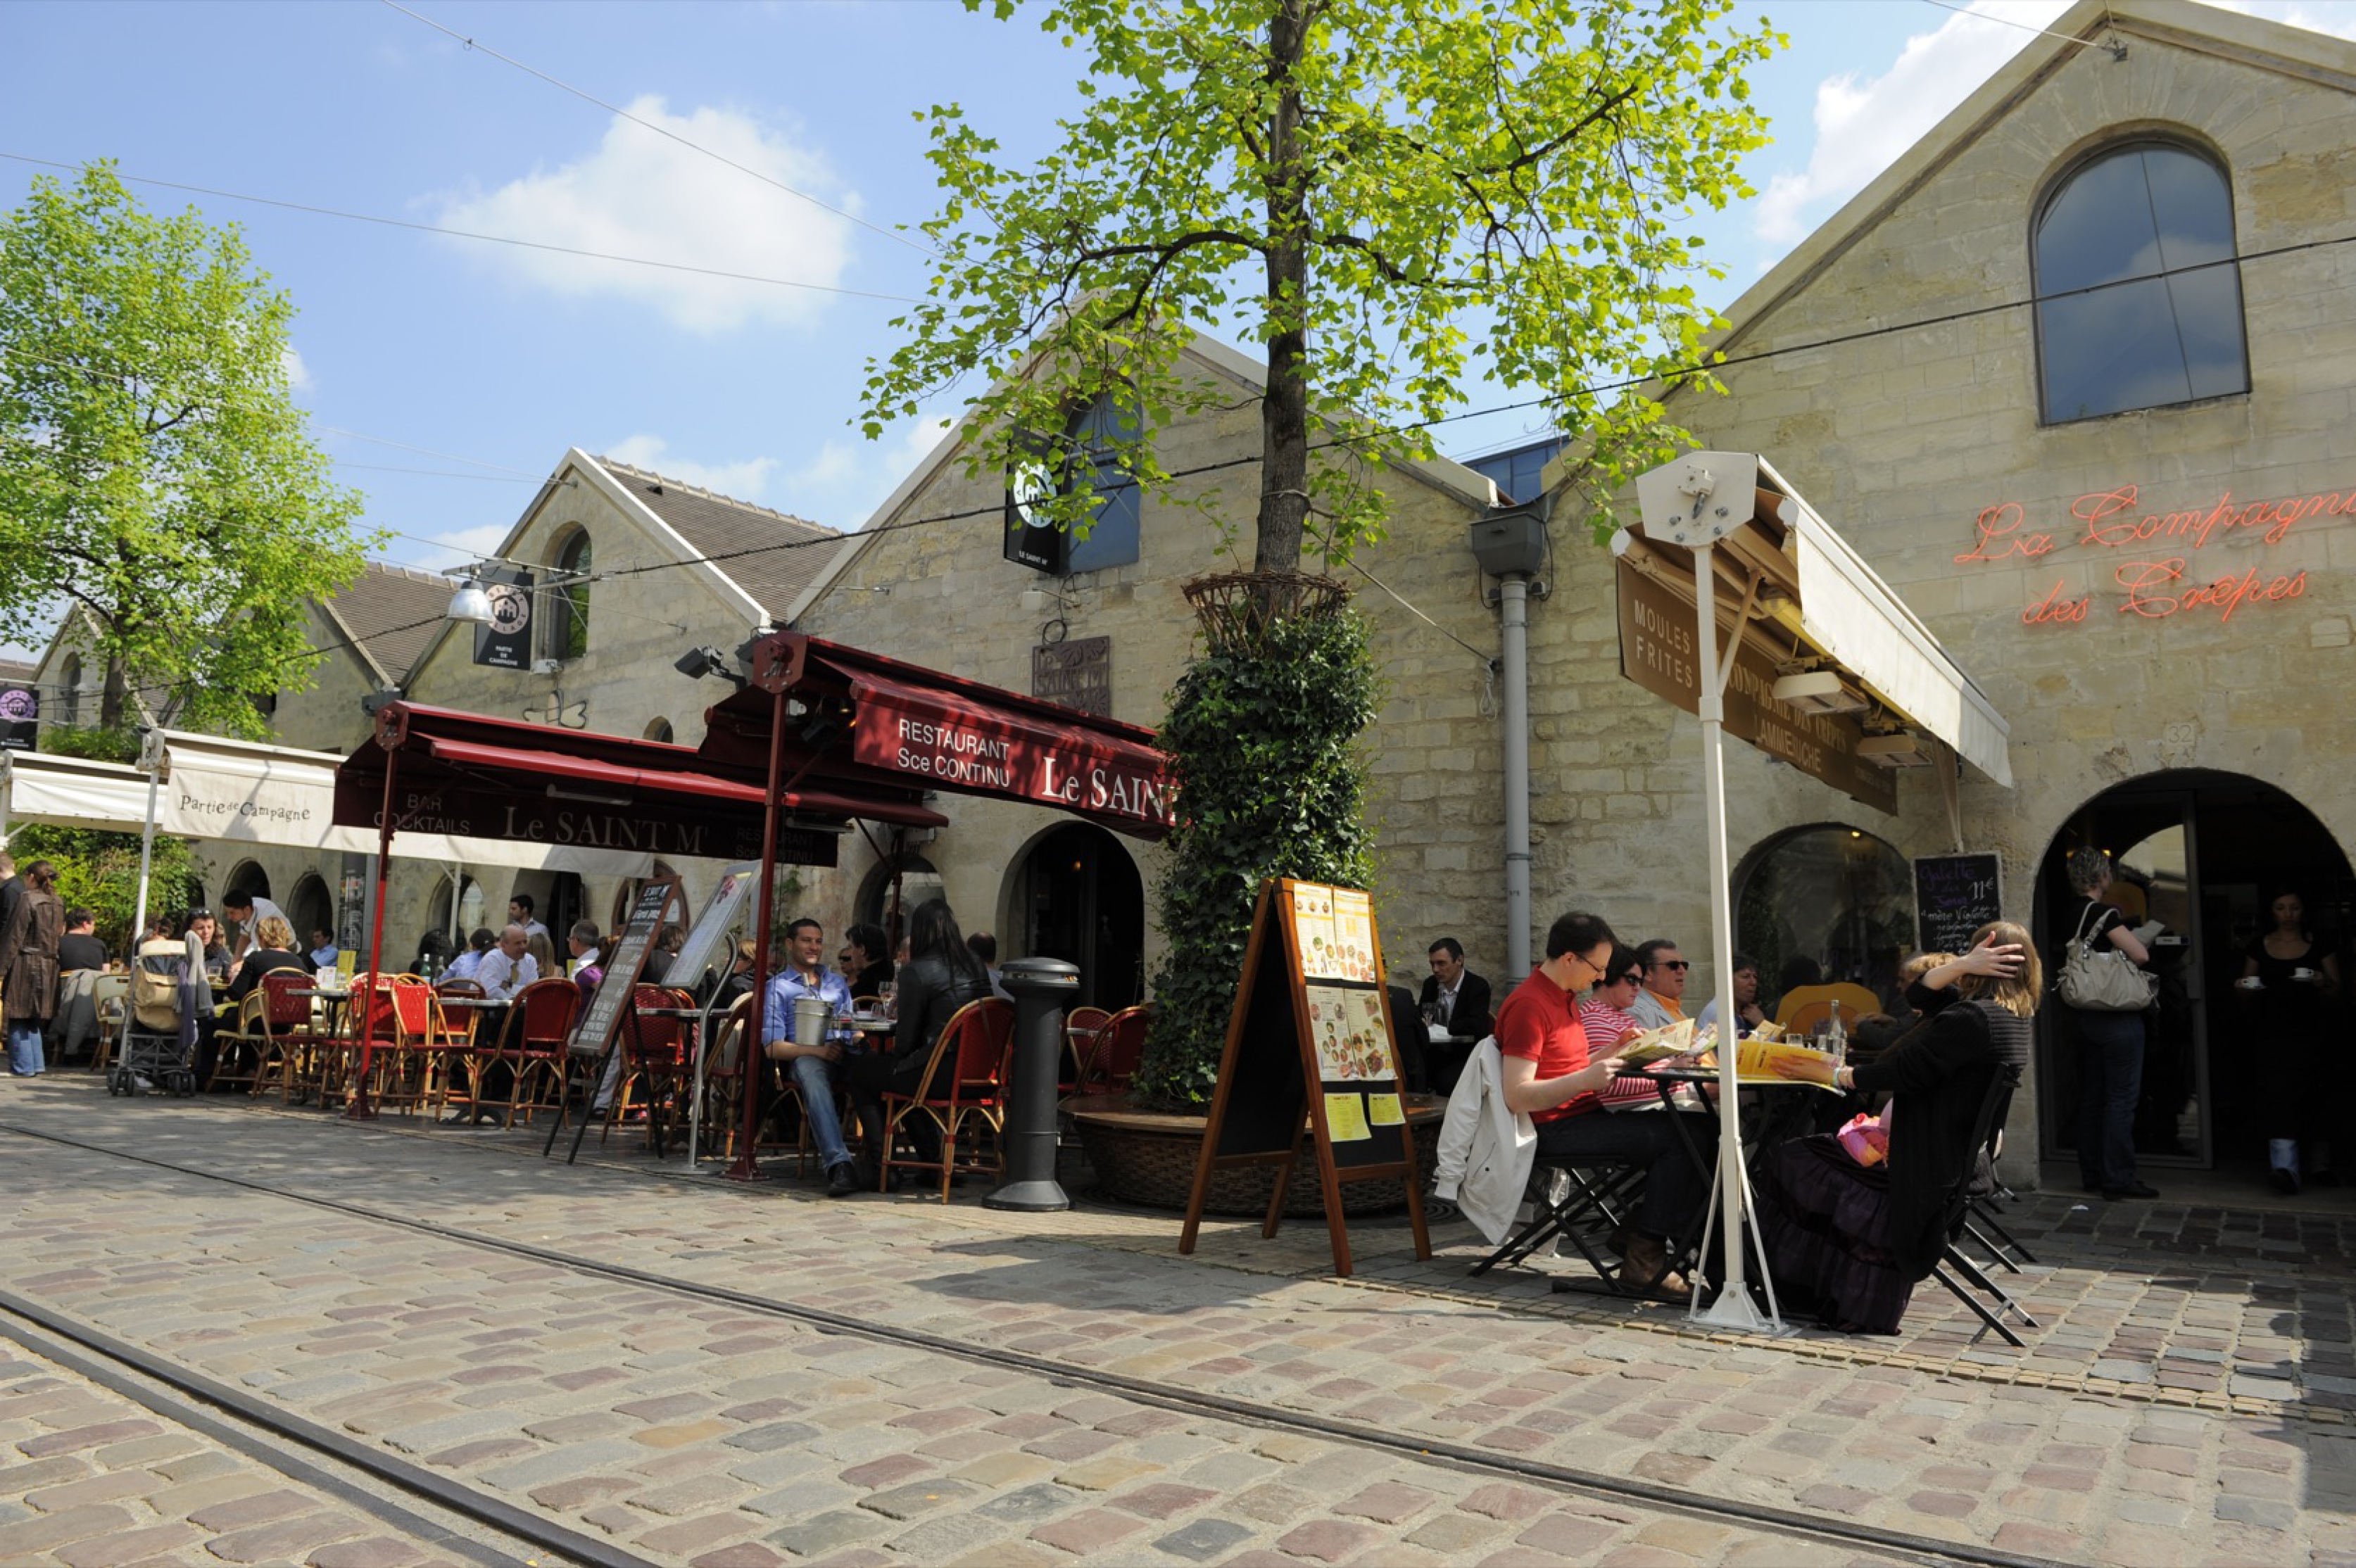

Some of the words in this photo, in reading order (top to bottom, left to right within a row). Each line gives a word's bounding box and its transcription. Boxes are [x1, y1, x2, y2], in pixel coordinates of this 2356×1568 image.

[1953, 502, 2054, 562] La
[2022, 579, 2089, 624] des
[2115, 558, 2307, 622] Crêpes
[1634, 599, 1692, 655] MOULES
[1635, 634, 1694, 689] FRITES
[898, 718, 1011, 761] RESTAURANT
[2169, 724, 2193, 744] 32
[897, 747, 931, 773] Sce
[935, 755, 1011, 788] CONTINU
[1041, 757, 1081, 802] Le
[179, 795, 226, 814] Partie
[227, 802, 239, 811] de
[239, 802, 310, 823] Campagne
[502, 806, 545, 840] Le
[555, 810, 668, 852] SAINT
[737, 826, 814, 847] RESURANT
